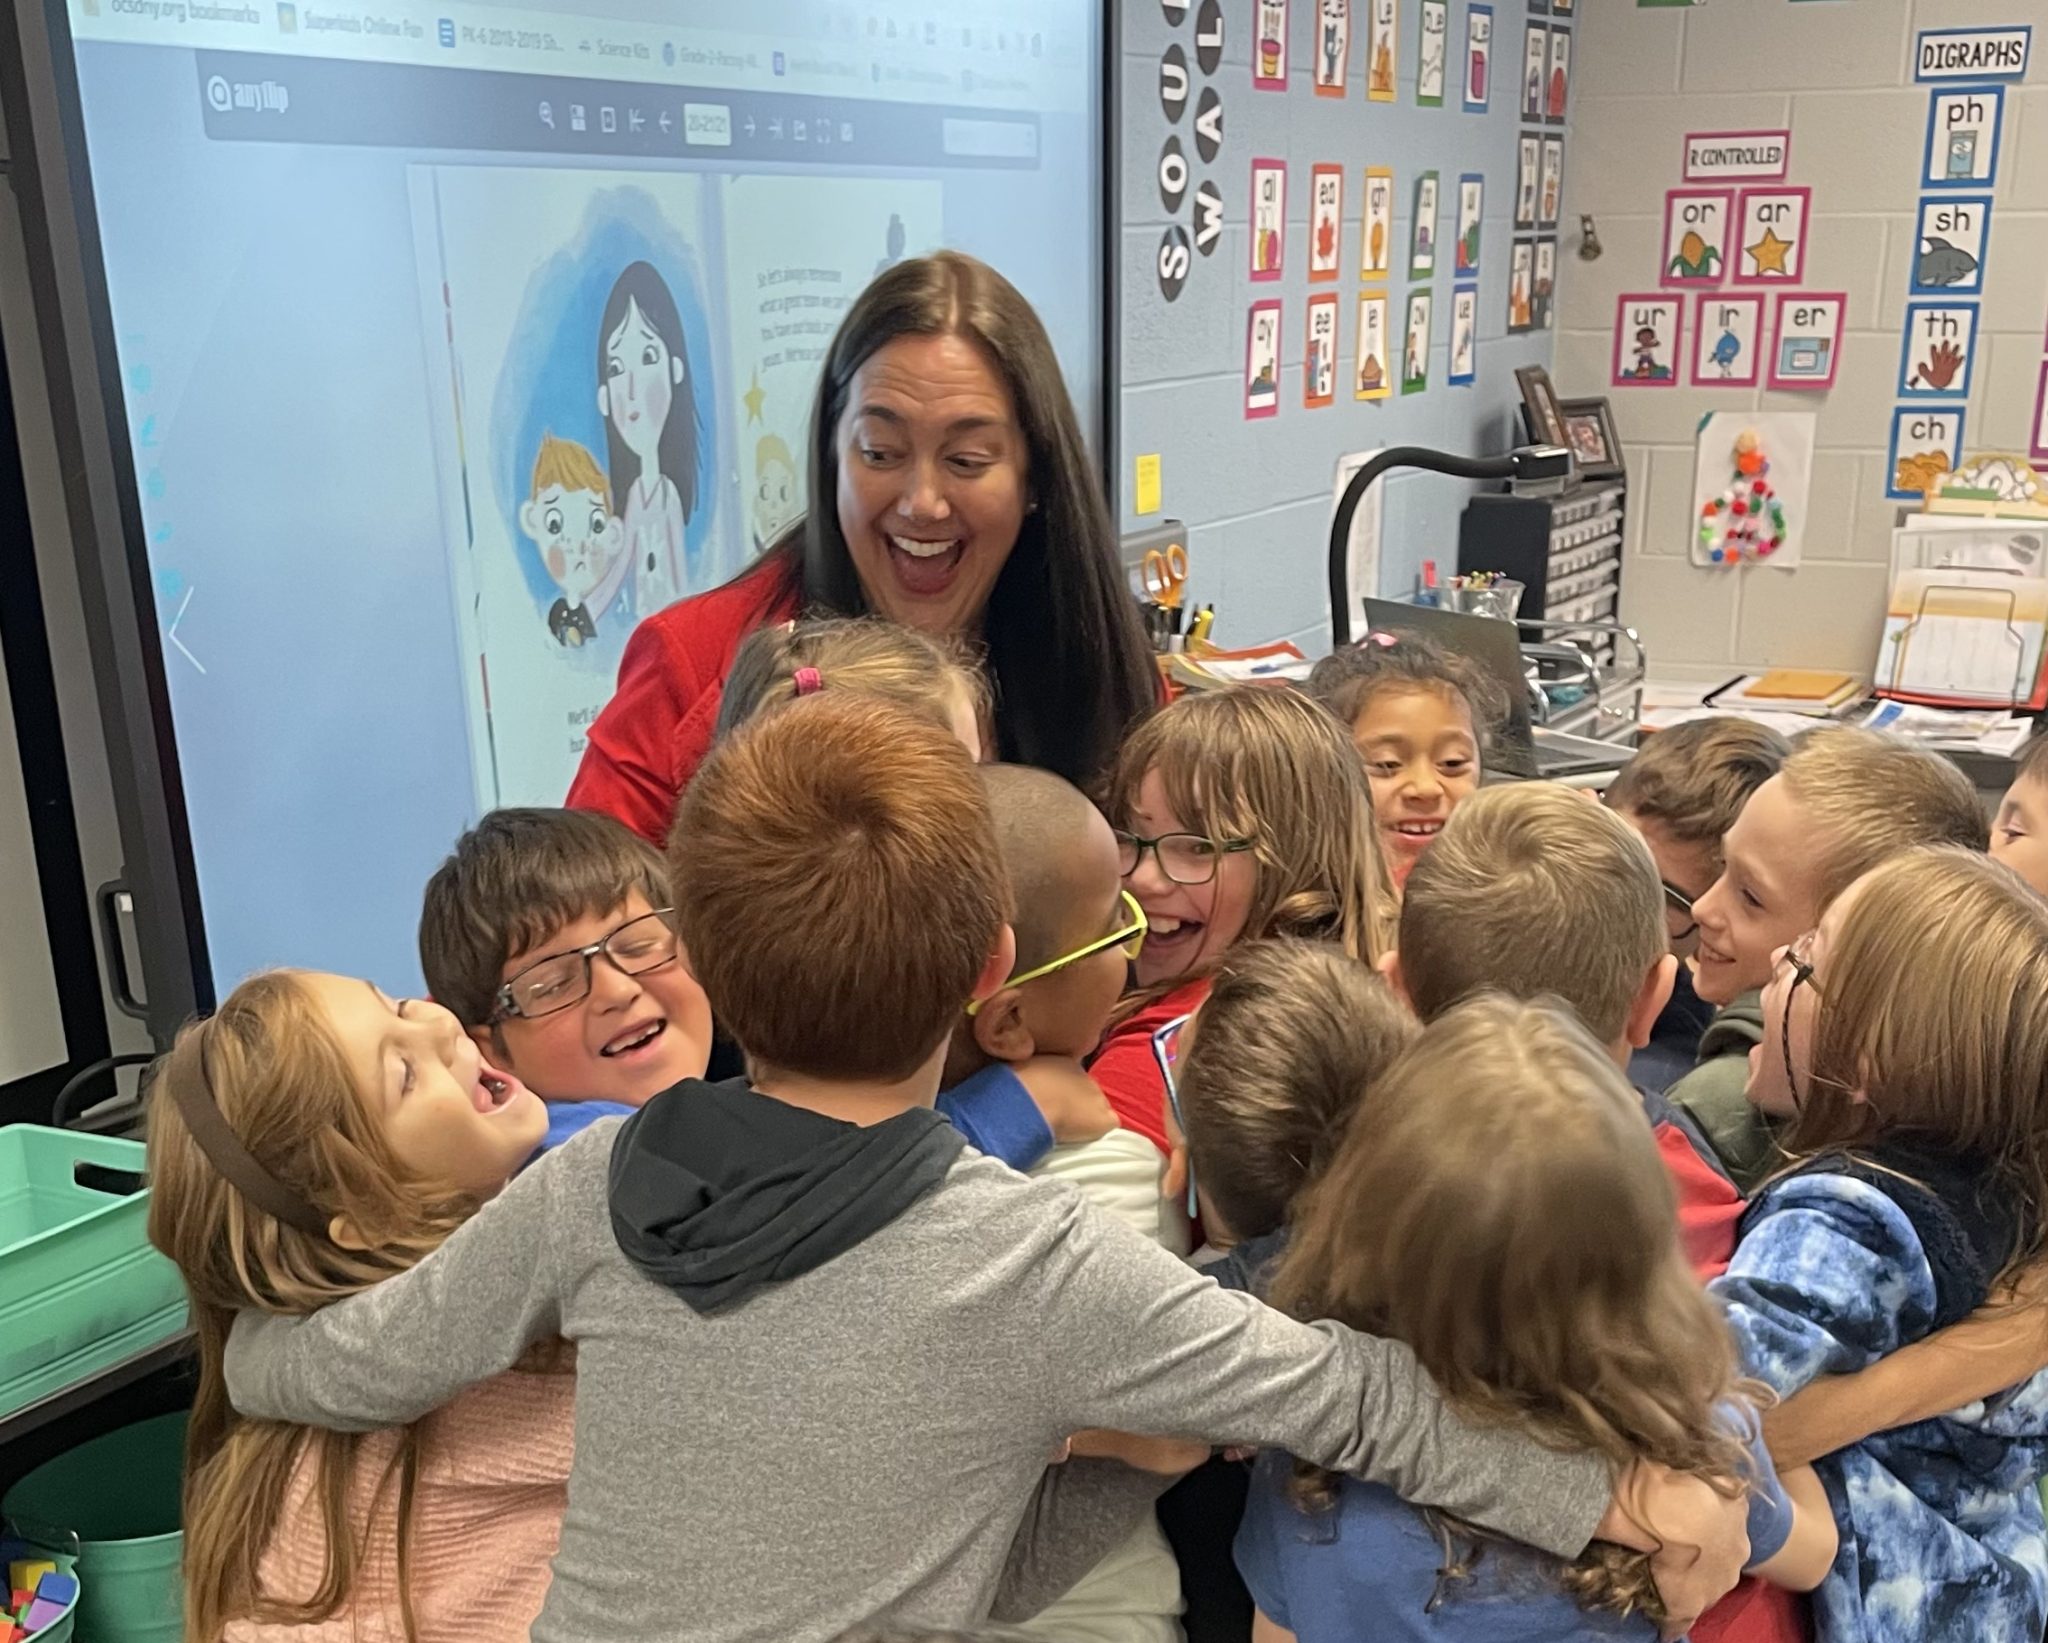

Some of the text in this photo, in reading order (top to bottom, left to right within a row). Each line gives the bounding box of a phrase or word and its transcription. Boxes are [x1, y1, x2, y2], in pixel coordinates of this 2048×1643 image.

[1922, 40, 2023, 70] DIGRAPHS
[1946, 96, 1984, 131] ph
[1701, 146, 1782, 166] CONTROLLED
[1682, 203, 1716, 224] or
[1756, 202, 1791, 224] ar
[1935, 205, 1971, 232] sh
[1633, 306, 1667, 327] ur
[1717, 303, 1740, 327] ir
[1792, 306, 1827, 328] er
[1923, 310, 1959, 338] th
[1910, 415, 1946, 441] ch
